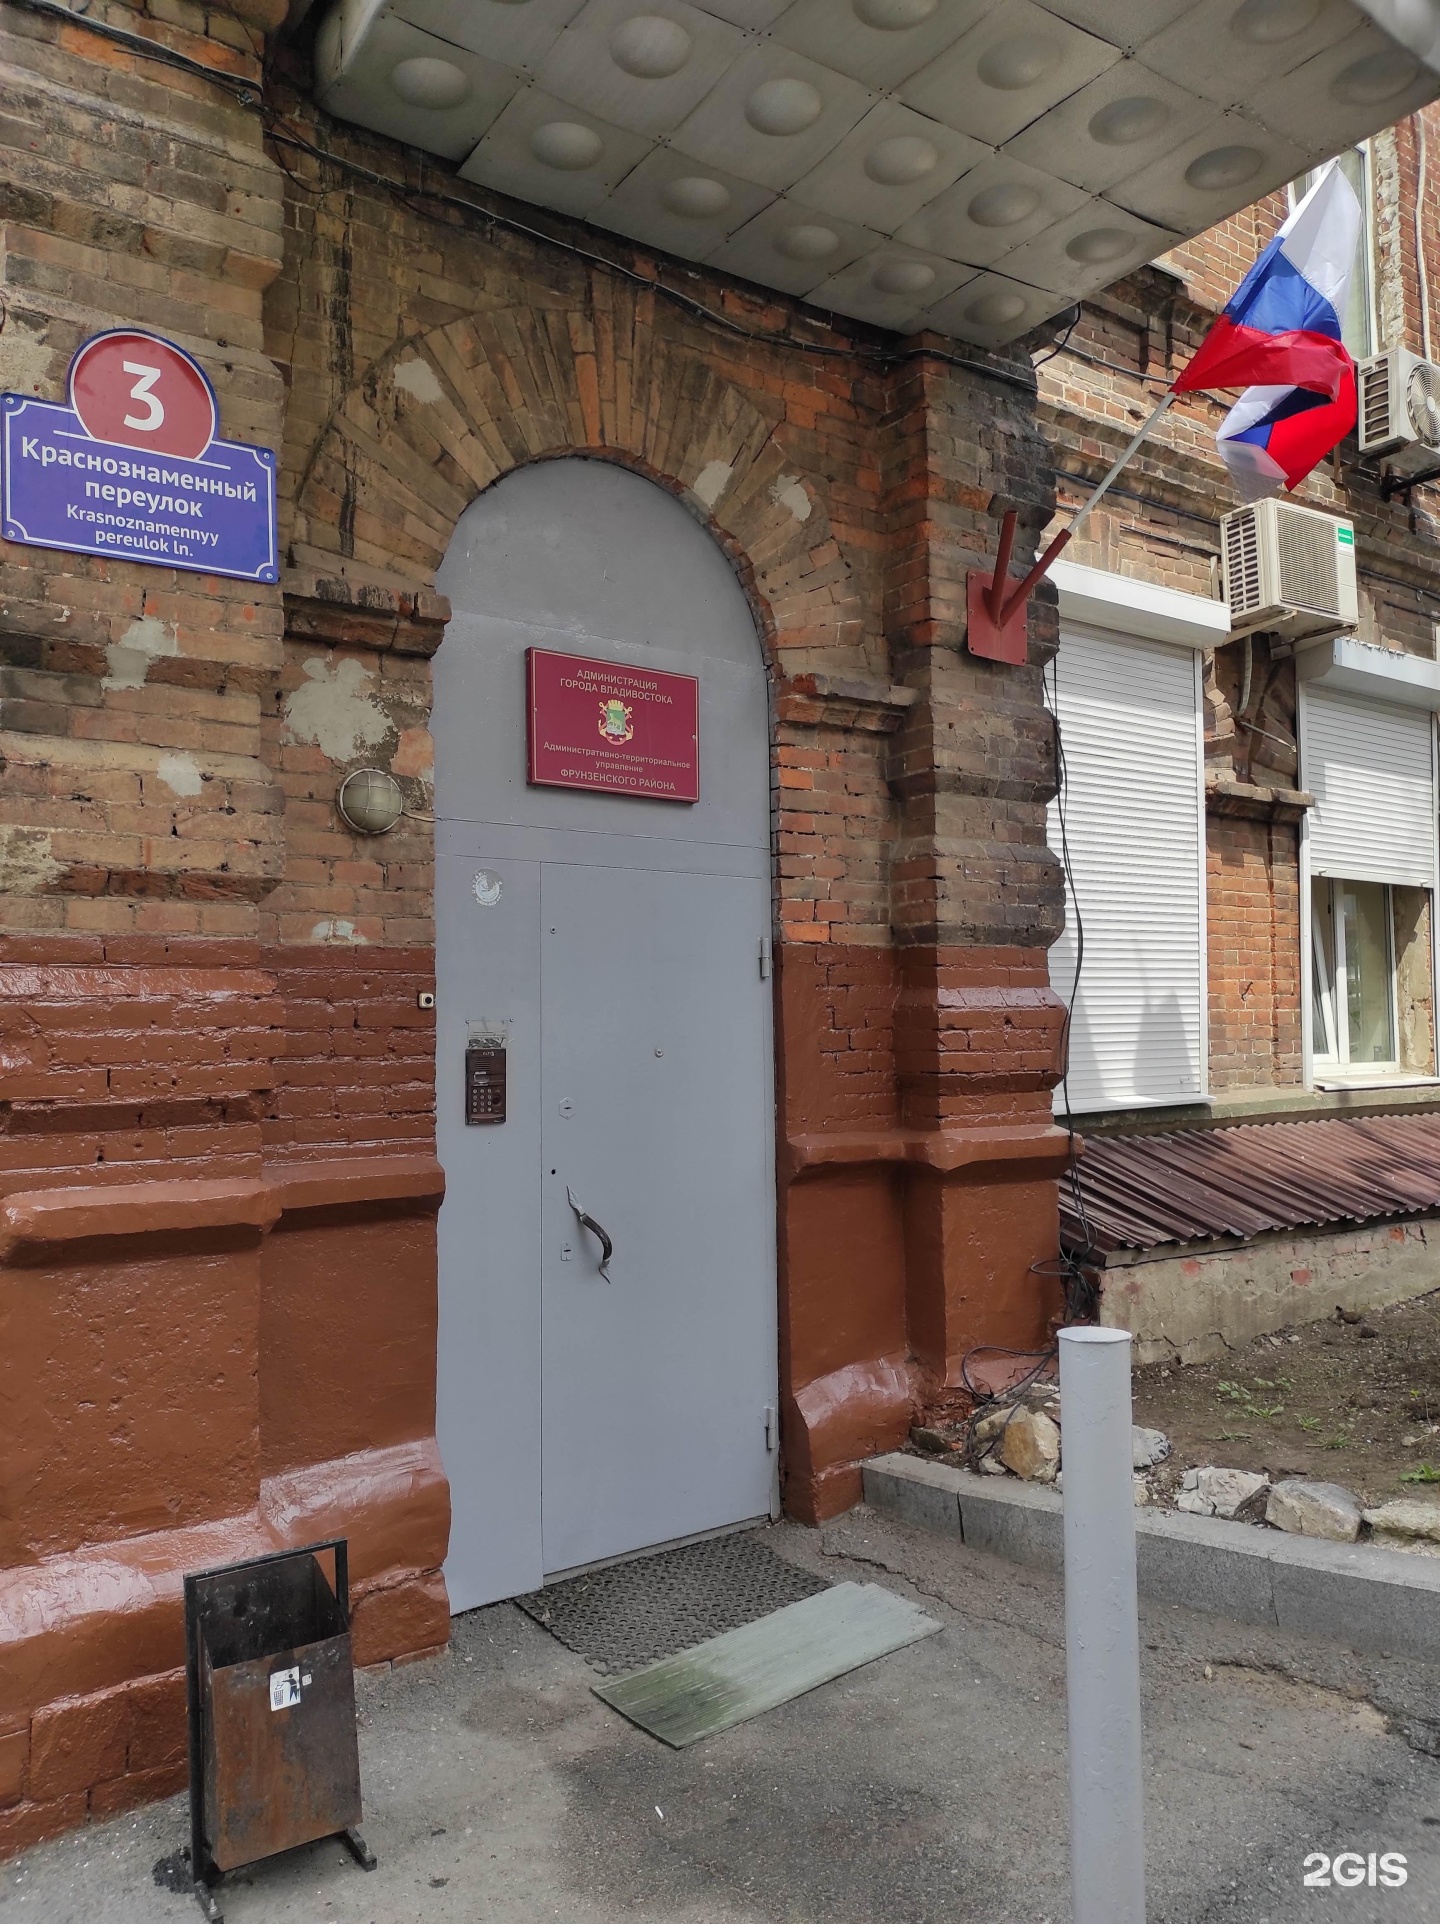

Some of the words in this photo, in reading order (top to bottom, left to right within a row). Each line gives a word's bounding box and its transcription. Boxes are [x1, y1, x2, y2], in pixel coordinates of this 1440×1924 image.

[123, 361, 165, 431] 3
[22, 436, 257, 502] Краснознаменный
[85, 481, 203, 518] переулок
[67, 504, 219, 546] Krasnoznamennyy
[95, 529, 169, 553] pereulok
[173, 540, 194, 557] ln.
[560, 678, 598, 693] ГОРОДА
[600, 684, 673, 705] ВЛАДИВОСТОКА
[577, 669, 658, 691] АДМИНИСТРАЦИЯ
[543, 741, 691, 769] Административно-территориальное
[595, 760, 643, 773] управление
[560, 768, 637, 786] ФРУНЗЕНСКОГО
[639, 778, 676, 791] РАЙОНА
